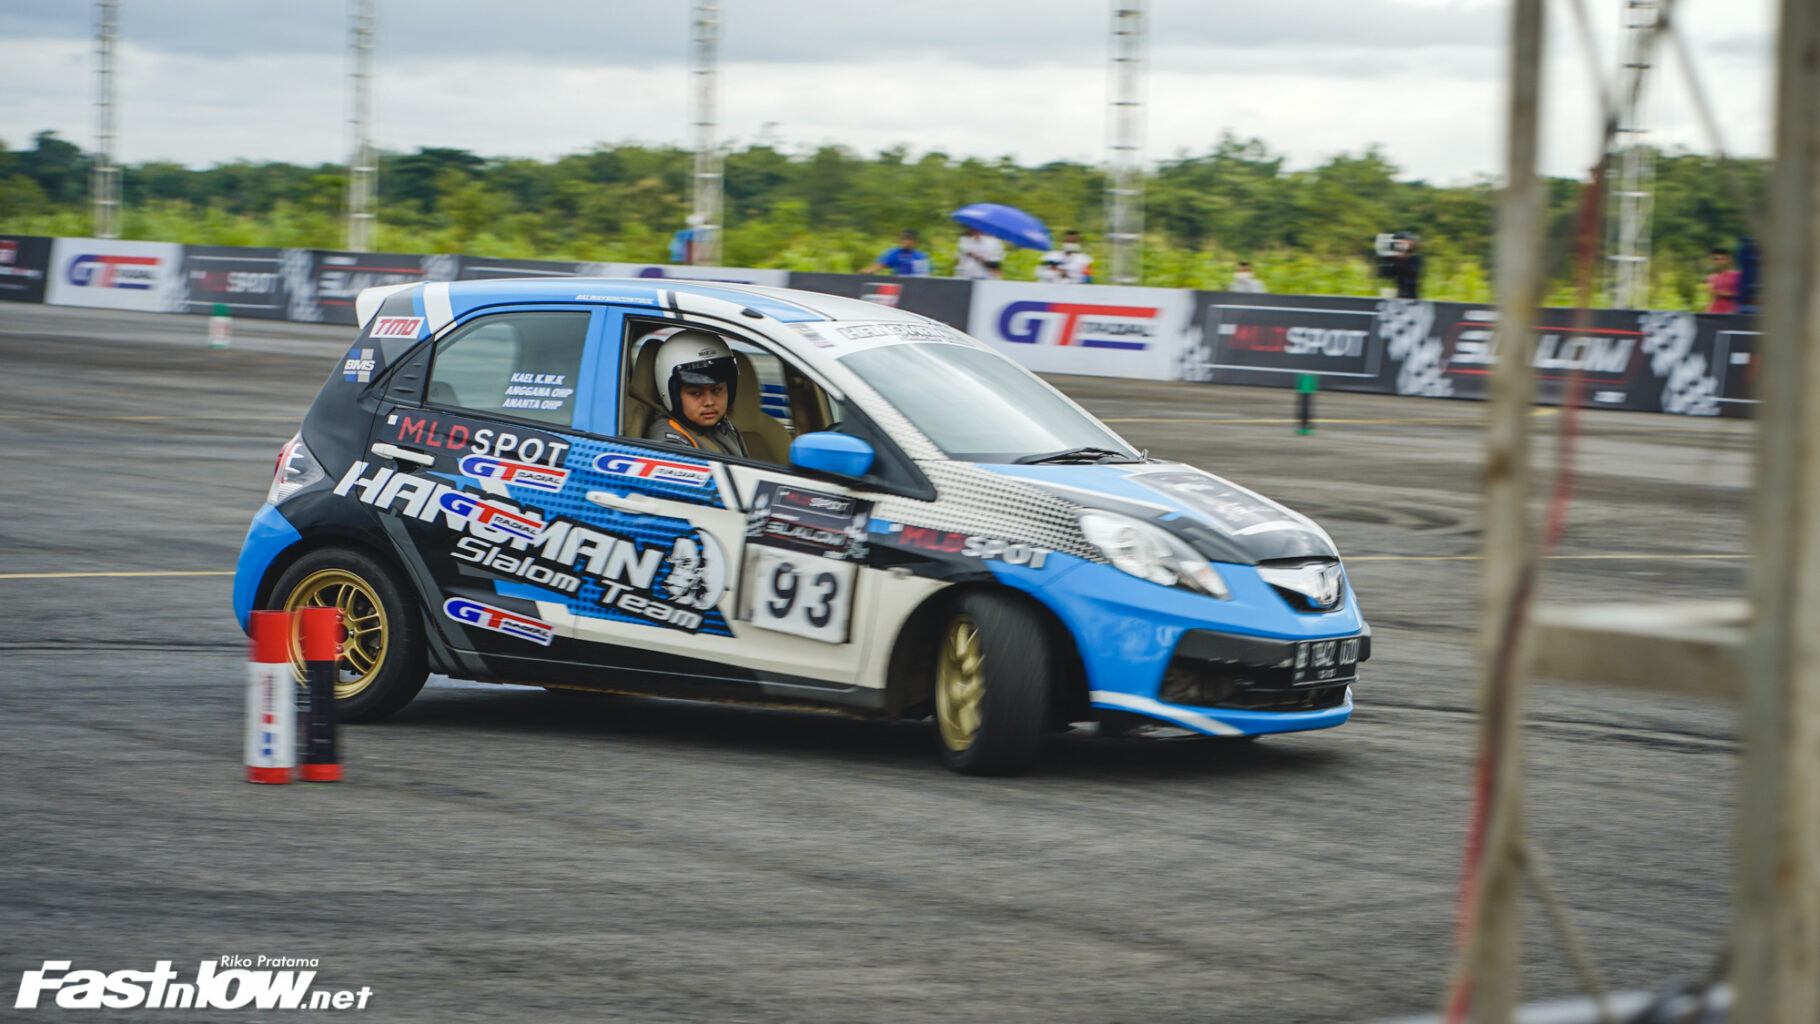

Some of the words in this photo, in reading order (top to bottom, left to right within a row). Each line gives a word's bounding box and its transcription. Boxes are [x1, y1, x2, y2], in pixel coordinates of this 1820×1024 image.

[996, 300, 1163, 346] GT
[344, 360, 376, 371] BMS
[1451, 329, 1637, 373] SLOM
[504, 385, 551, 397] ANGGANA
[511, 372, 535, 384] KAEL
[502, 398, 540, 410] ANANTA
[398, 416, 570, 467] MLDSPOT
[462, 456, 567, 482] GT
[597, 454, 712, 478] GT
[440, 492, 543, 525] GT
[494, 515, 537, 536] RADIAL
[451, 536, 581, 593] Slalom
[601, 579, 704, 631] Team
[767, 562, 838, 628] 93
[446, 600, 554, 629] GT
